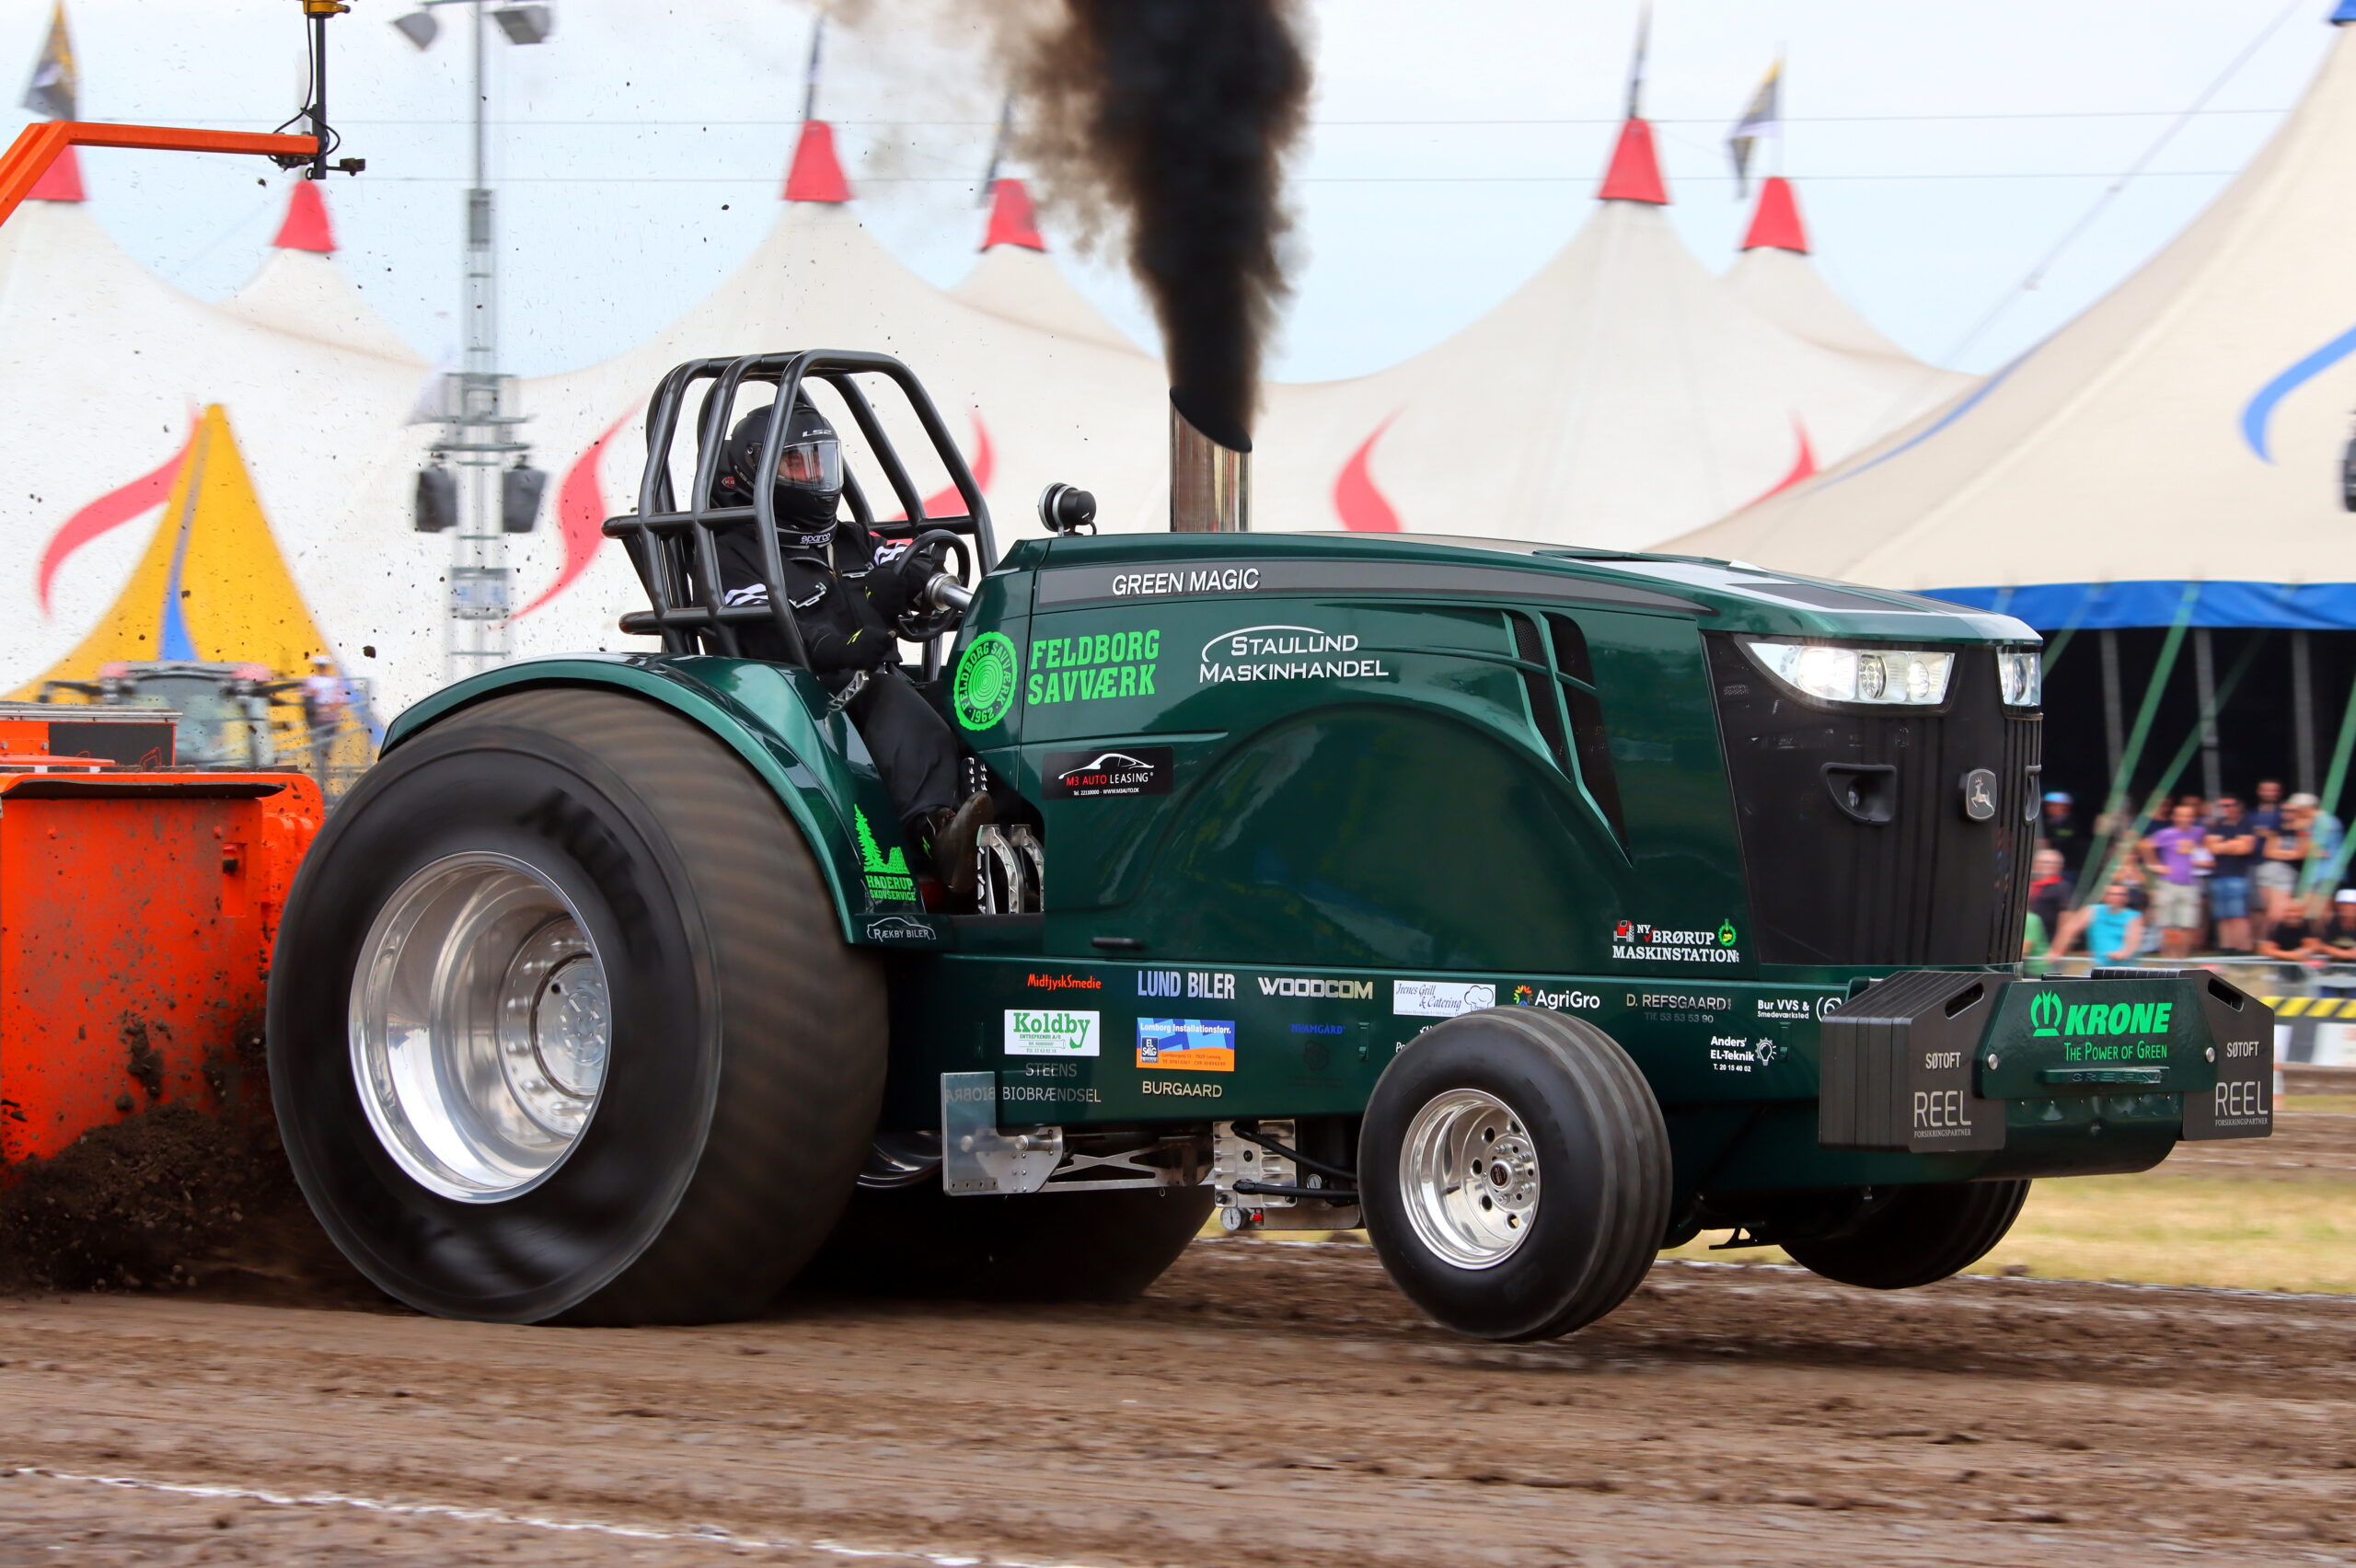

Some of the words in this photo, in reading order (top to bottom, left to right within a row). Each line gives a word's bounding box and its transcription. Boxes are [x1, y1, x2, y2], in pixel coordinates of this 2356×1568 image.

[803, 429, 832, 437] LS2
[1113, 572, 1184, 596] GREEN
[1189, 568, 1260, 592] MAGIC
[1031, 629, 1161, 670] FELDBORG
[1231, 635, 1358, 656] STAULUND
[959, 642, 989, 711] FELDBORG
[991, 642, 1011, 706] SAVVÆRK
[1200, 660, 1389, 683] MASKINHANDEL
[1028, 663, 1157, 705] SAVVÆRK
[971, 708, 995, 723] 1962
[1066, 775, 1080, 786] M3
[1082, 775, 1107, 786] AUTO
[1110, 773, 1149, 784] LEASING
[865, 875, 914, 890] HADERUP
[870, 889, 917, 901] SKOVSERVICE
[873, 928, 904, 942] RÆKBY
[907, 929, 930, 940] BILER
[1637, 924, 1651, 934] NY
[1652, 929, 1715, 945] BRØRUP
[1612, 945, 1737, 963] MASKINSTATION
[1138, 971, 1181, 997] LUND
[1187, 972, 1235, 999] BILER
[1257, 977, 1373, 999] WOODCOM
[1419, 984, 1437, 997] Grill
[1419, 996, 1426, 1009] &
[1427, 996, 1461, 1011] Catering
[1535, 990, 1600, 1010] AgriGro
[1627, 994, 1637, 1007] D.
[1643, 994, 1727, 1010] REFSGAARD
[1758, 999, 1773, 1009] Bur
[1776, 999, 1799, 1010] VVS
[1802, 1001, 1810, 1011] &
[1674, 1013, 1685, 1021] 53
[1688, 1014, 1700, 1022] 53
[1702, 1014, 1714, 1023] 90
[2064, 1002, 2173, 1036] KRONE
[1013, 1012, 1091, 1046] Koldby
[1141, 1023, 1171, 1033] Lomborg
[1146, 1039, 1153, 1047] EL
[2227, 1042, 2259, 1058] SØTOFT
[1710, 1050, 1754, 1061] EL-Teknik
[1925, 1052, 1961, 1069] SØTOFT
[1025, 1063, 1078, 1078] STEENS
[1002, 1086, 1102, 1102] BIOBRÆNDSEL
[1142, 1081, 1223, 1098] BURGAARD
[2215, 1080, 2269, 1116] REEL
[1914, 1090, 1971, 1128] REEL
[2215, 1118, 2268, 1127] FORSIKRINGSPARTNER
[1913, 1128, 1971, 1138] FORSIKRINGSPARTNER
